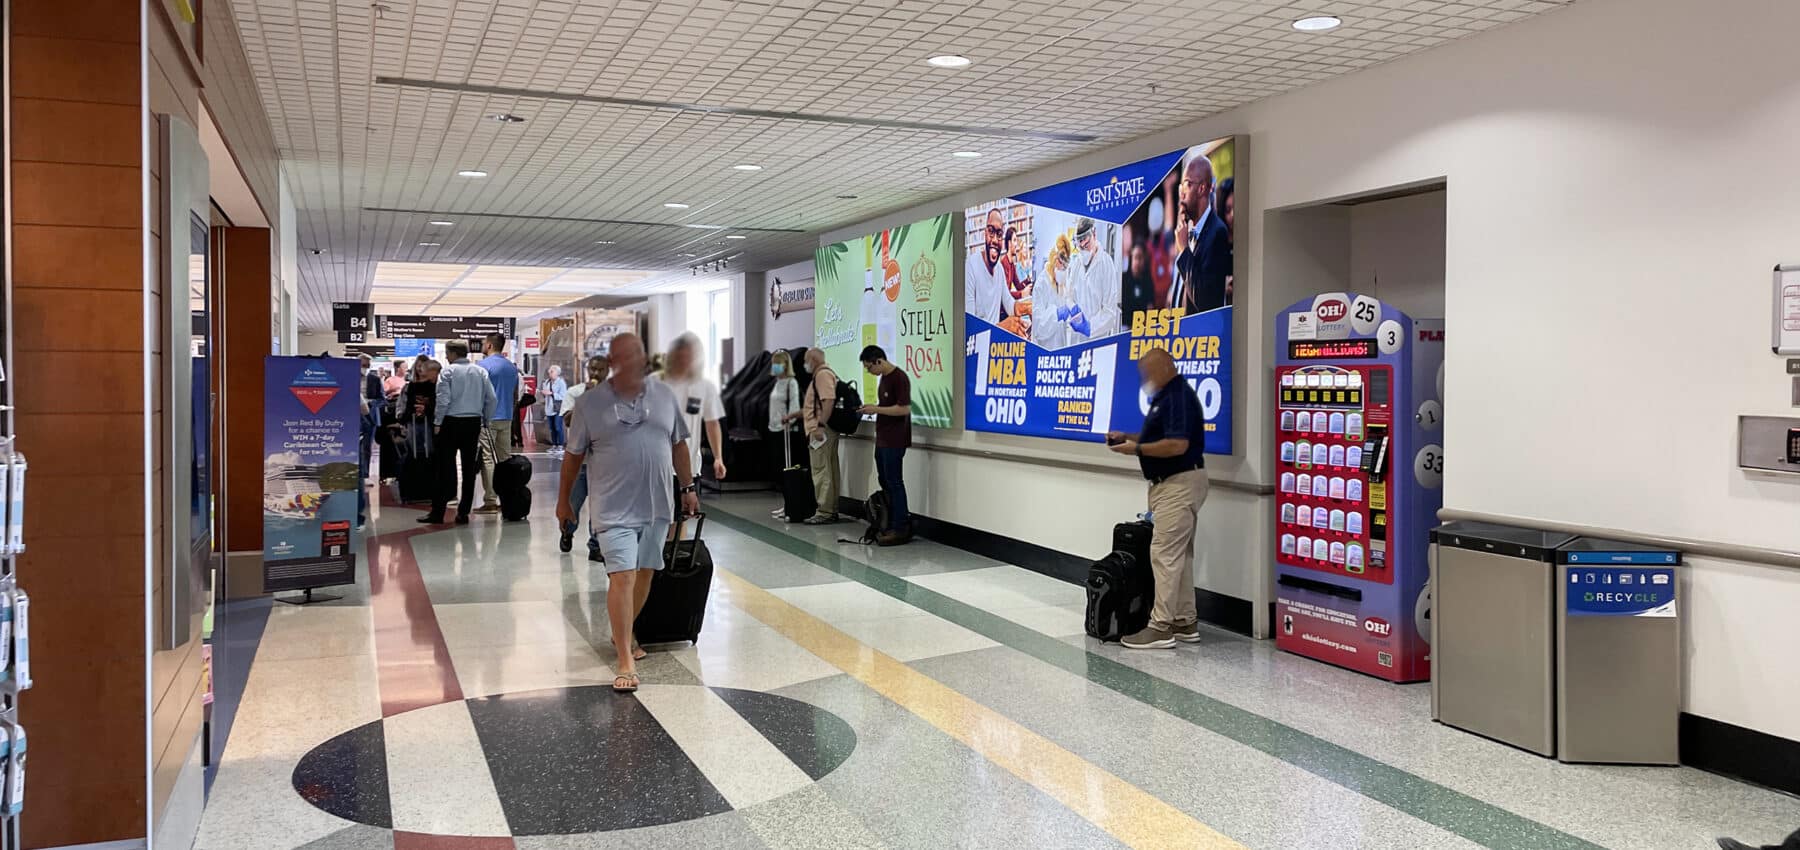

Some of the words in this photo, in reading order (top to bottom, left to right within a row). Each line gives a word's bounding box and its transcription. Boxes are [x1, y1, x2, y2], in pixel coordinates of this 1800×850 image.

[1086, 185, 1113, 206] KENT
[1114, 176, 1145, 199] STATE
[1089, 196, 1140, 213] UNIVERSITY
[885, 271, 901, 290] NEW!
[1318, 303, 1344, 318] OH!
[1355, 301, 1375, 323] 25
[350, 317, 367, 328] B4
[900, 308, 947, 341] STELLA
[1131, 307, 1185, 337] BEST
[350, 333, 363, 342] B2
[1387, 331, 1396, 346] 3
[1419, 330, 1446, 342] PLA
[990, 341, 1027, 357] ONLINE
[904, 345, 943, 378] ROSA
[1037, 355, 1072, 369] HEALTH
[988, 358, 1027, 385] MBA
[1036, 370, 1066, 384] POLICY
[1068, 371, 1075, 384] &
[988, 387, 995, 397] IN
[995, 387, 1027, 397] NORTHEAST
[1034, 385, 1095, 399] MANAGEMENT
[985, 397, 1027, 425] OHIO
[1057, 400, 1093, 414] RANKED
[1058, 414, 1065, 424] IN
[1065, 414, 1077, 424] THE
[1077, 414, 1090, 425] U.S.
[1596, 592, 1657, 602] RECYCLE
[1364, 620, 1390, 635] OH!
[1302, 632, 1357, 653] ohiolottery.com
